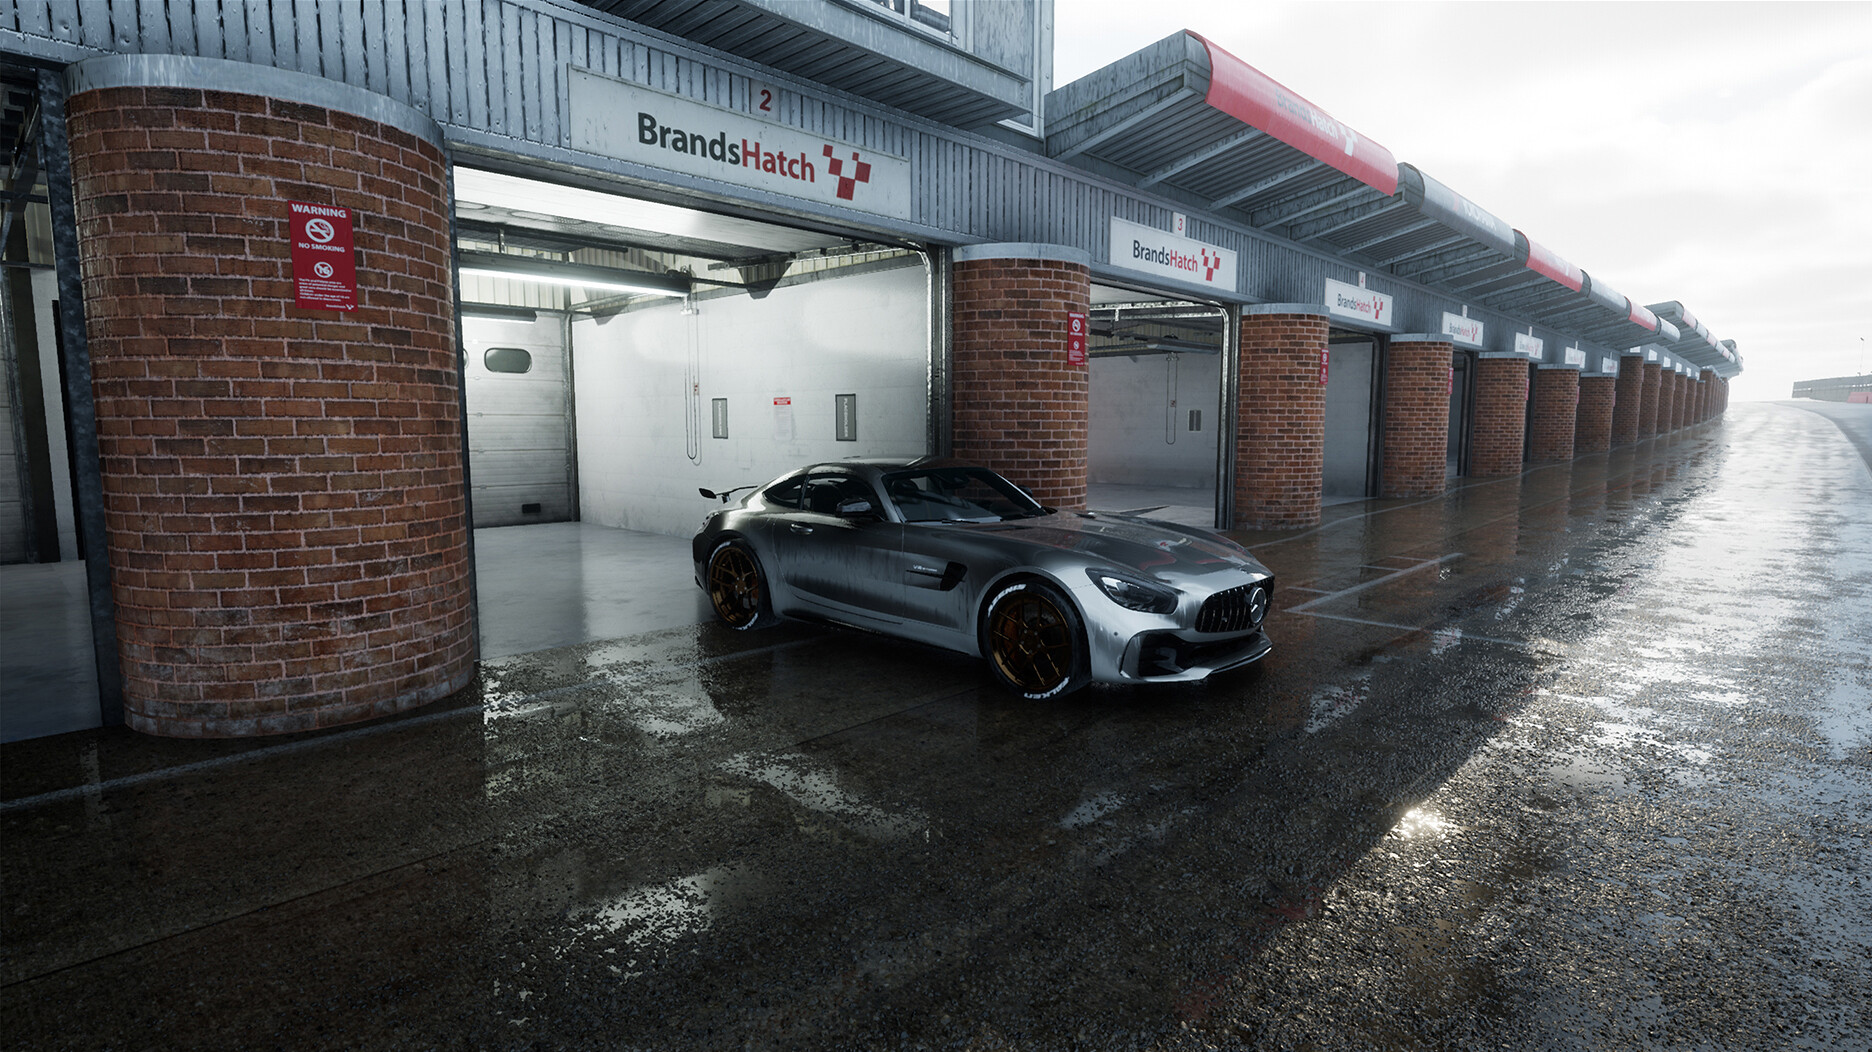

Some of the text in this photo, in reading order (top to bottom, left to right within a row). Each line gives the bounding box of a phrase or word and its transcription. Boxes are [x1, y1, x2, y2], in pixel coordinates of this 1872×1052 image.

[759, 89, 772, 111] 2
[638, 112, 815, 183] BrandsHatch
[291, 203, 346, 218] WARNING
[1177, 218, 1184, 231] 3
[298, 242, 345, 252] NO SMOKING
[1133, 239, 1198, 272] BrandsHatch
